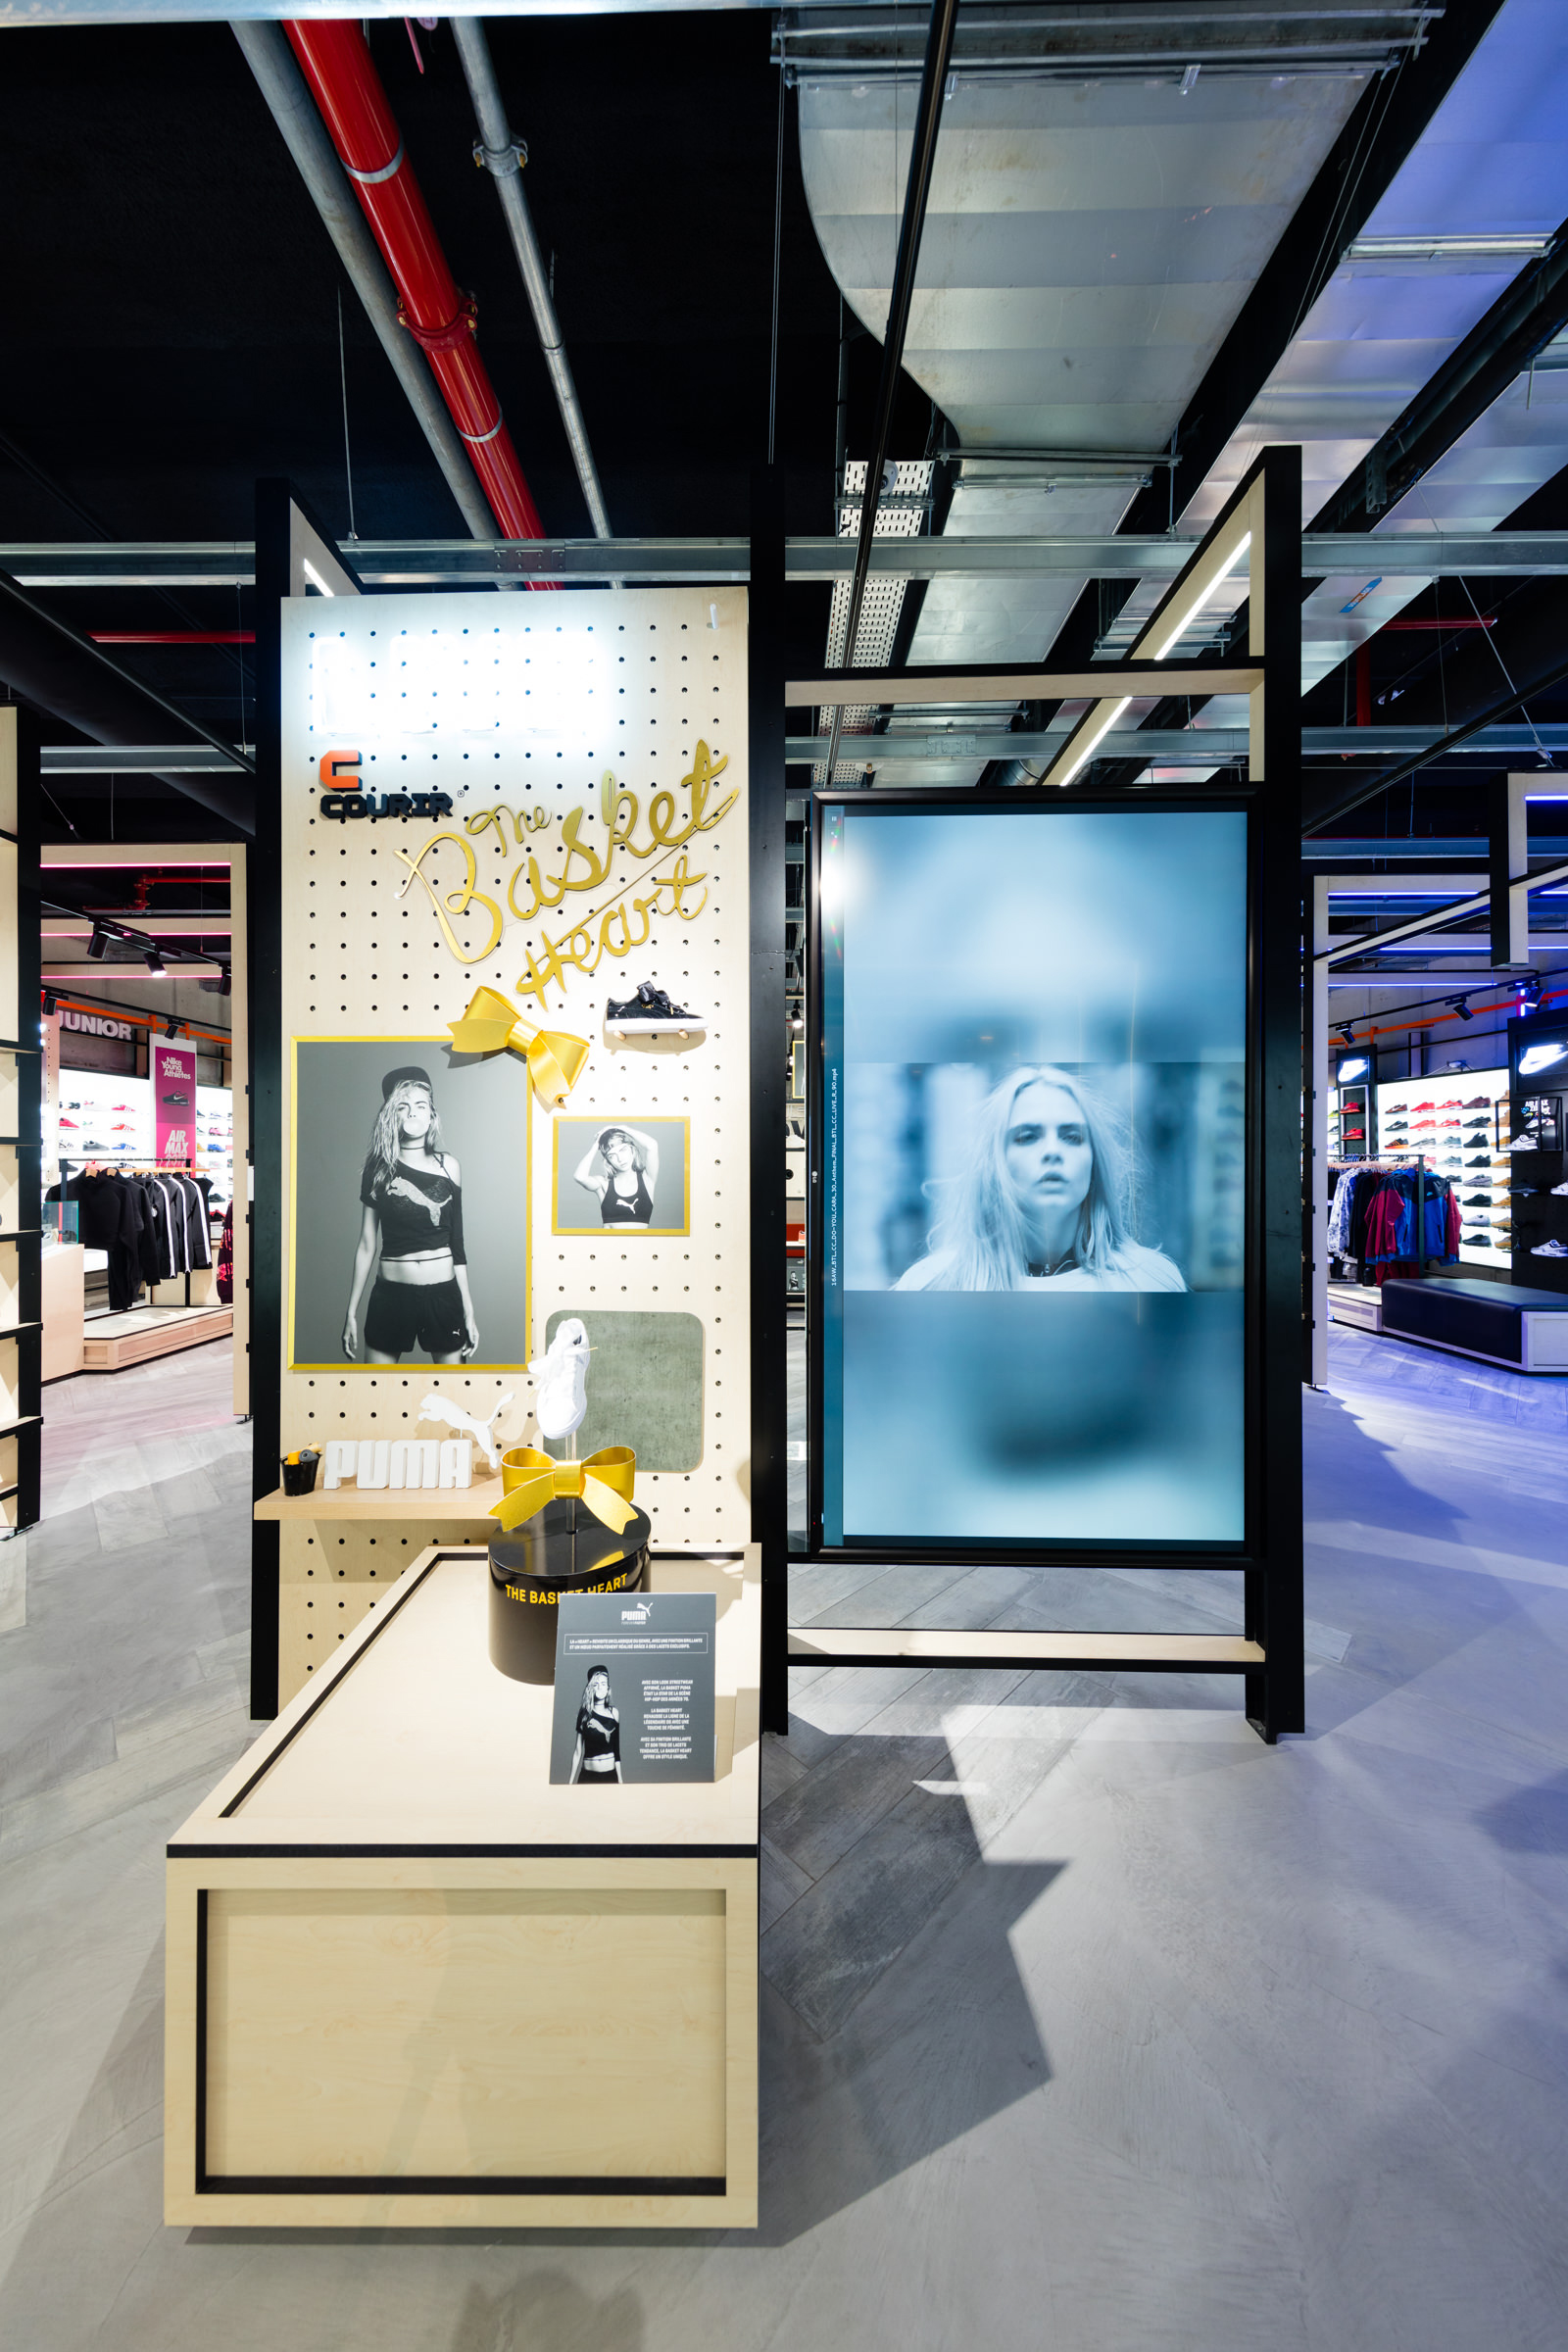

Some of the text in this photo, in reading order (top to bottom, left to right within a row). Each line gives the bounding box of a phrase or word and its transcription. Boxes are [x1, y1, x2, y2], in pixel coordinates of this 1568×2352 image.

[320, 793, 453, 818] COURIR
[466, 805, 552, 857] The
[394, 739, 740, 964] Basket
[515, 855, 708, 1012] Heart
[59, 1010, 132, 1041] JUNIOR
[162, 1060, 182, 1072] Young
[167, 1056, 182, 1066] Nike
[164, 1069, 191, 1080] Athletes
[169, 1130, 186, 1143] AIR
[165, 1142, 188, 1154] MAX
[323, 1439, 472, 1490] PUMA
[506, 1584, 526, 1602] THE
[529, 1589, 584, 1604] BAS
[621, 1610, 647, 1621] PUMA
